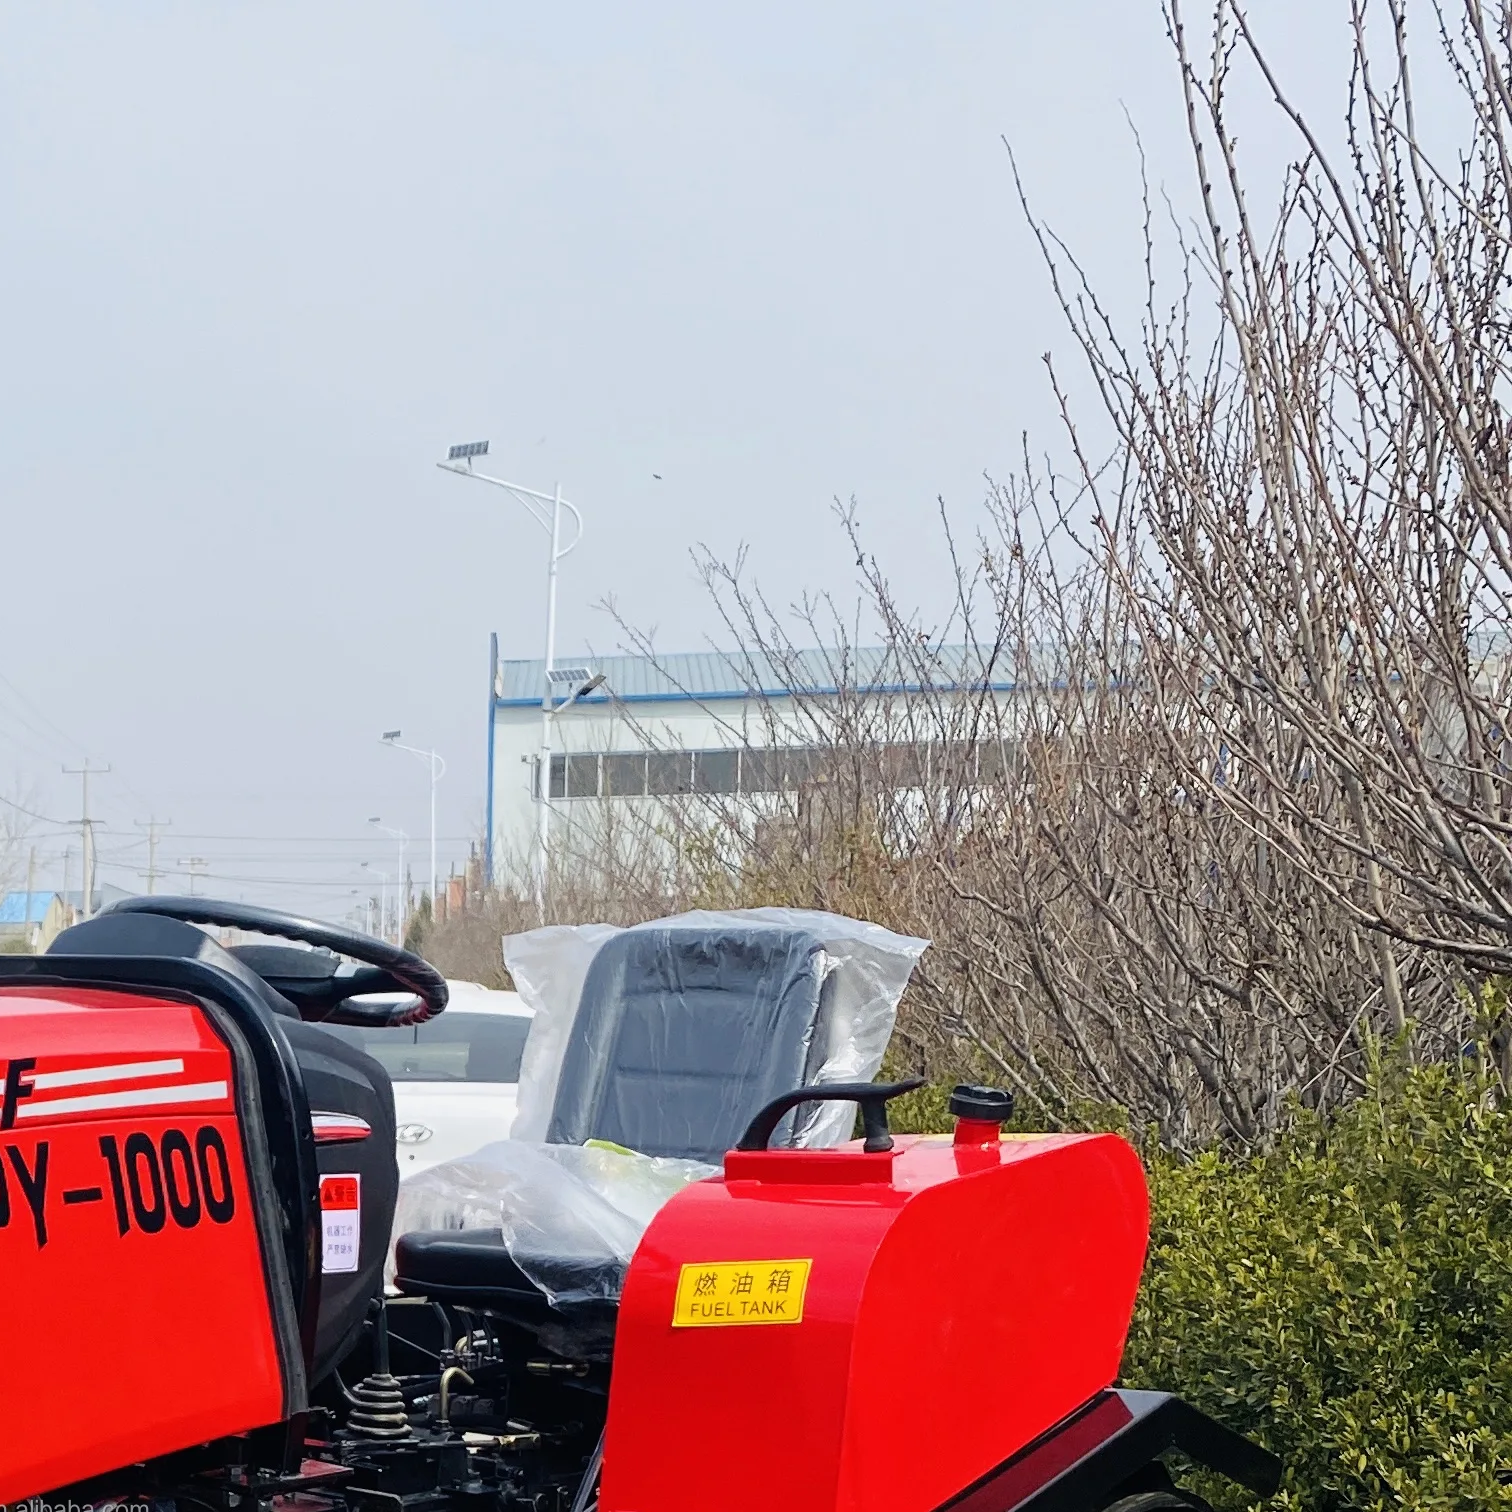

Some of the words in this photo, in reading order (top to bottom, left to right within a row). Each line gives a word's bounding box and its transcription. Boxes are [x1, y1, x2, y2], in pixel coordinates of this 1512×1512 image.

[693, 1269, 793, 1297] 燃油箱
[690, 1302, 735, 1318] FUEL
[740, 1300, 787, 1316] TANK
